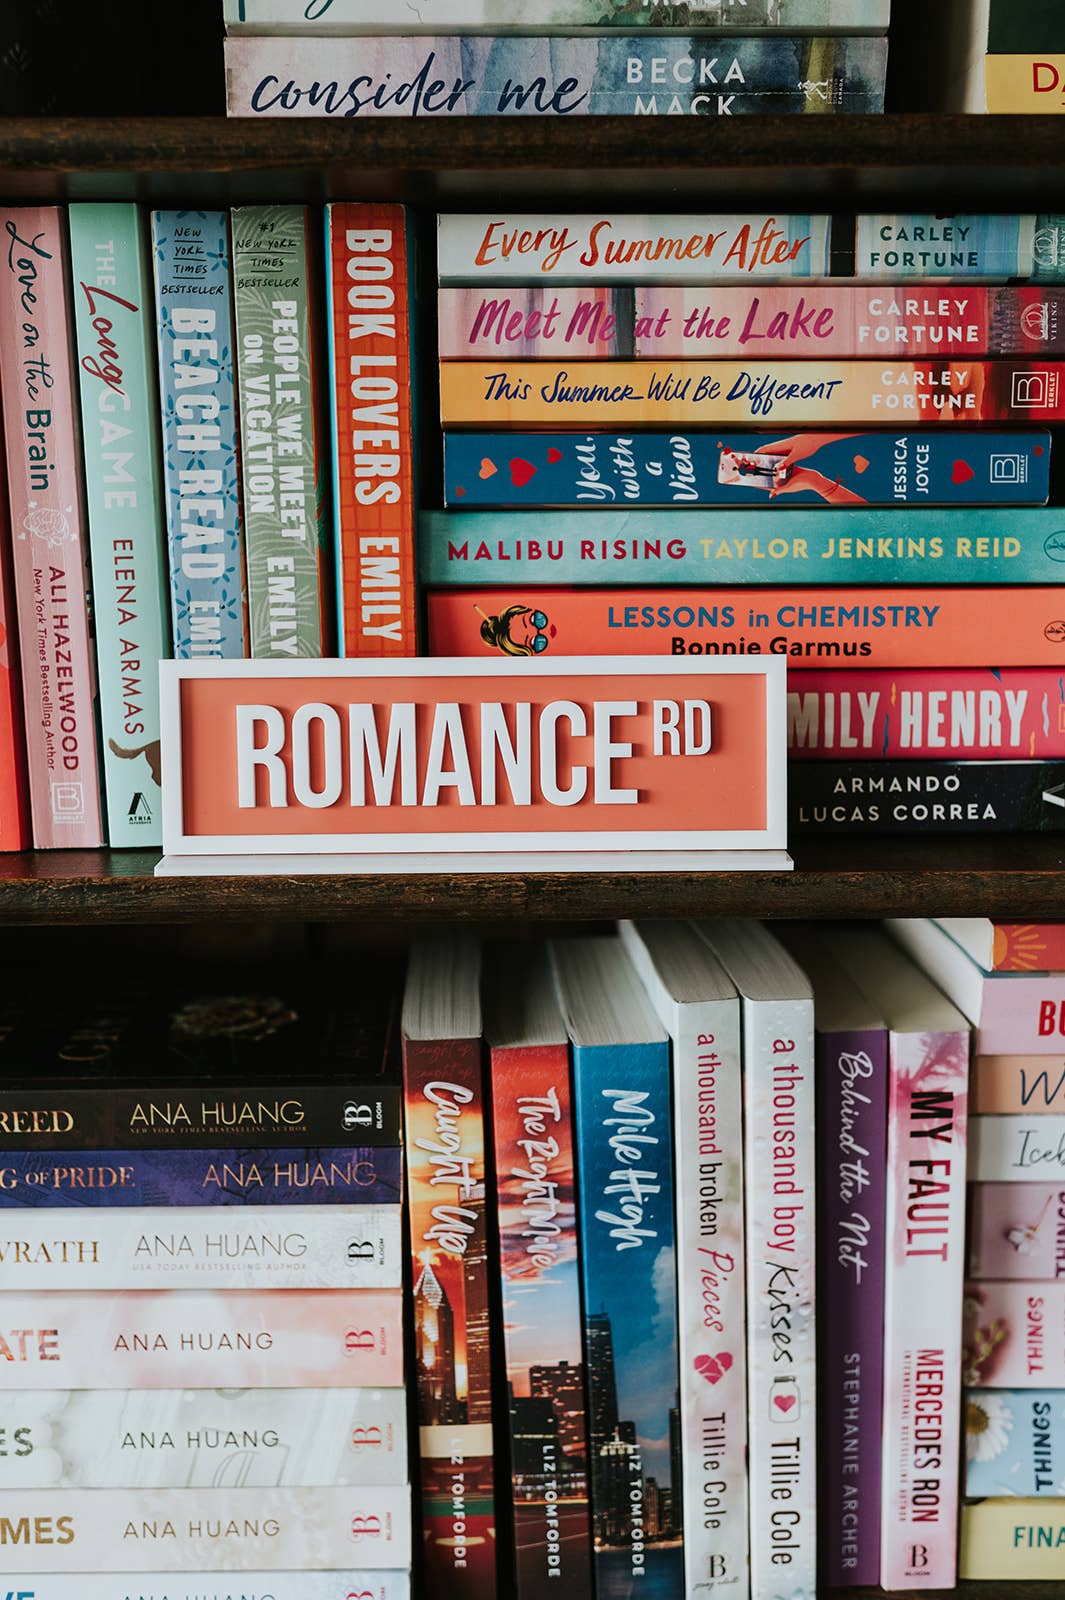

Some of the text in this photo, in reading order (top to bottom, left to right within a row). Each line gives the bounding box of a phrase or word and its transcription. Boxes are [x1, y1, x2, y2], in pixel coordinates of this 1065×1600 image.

[251, 51, 589, 117] consider me
[626, 57, 746, 83] BECKA
[634, 95, 736, 115] MACK
[174, 227, 202, 237] NEW
[174, 244, 205, 256] YORK
[235, 237, 298, 249] NEW YORK
[258, 222, 275, 233] #1
[474, 217, 811, 273] Every Summer After
[879, 226, 971, 242] CARLEY
[173, 263, 208, 275] TIMES
[237, 276, 301, 289] BESTSELLER
[251, 256, 285, 267] TIMES
[870, 251, 979, 267] FORTUNE
[161, 284, 225, 296] BESTSELLER
[868, 299, 969, 316] CARLEY
[468, 296, 835, 345] Meet Me at the Lake
[858, 325, 980, 344] FORTUNE
[1050, 301, 1058, 341] VIKING
[5, 220, 56, 491] Love on the Brain
[80, 239, 140, 510] THE Long GAME
[345, 229, 402, 506] BOOK LOVERS
[880, 370, 969, 386] CARLEY
[483, 371, 534, 401] This
[647, 371, 687, 402] Will
[692, 376, 722, 402] Be
[871, 393, 977, 409] FORTUNE
[1048, 371, 1056, 408] BERKLEY
[171, 307, 226, 580] BEACH READ
[242, 333, 276, 514] ON VACATION
[271, 300, 307, 542] PEOPLE WE MEET
[608, 437, 641, 499] with
[645, 461, 664, 476] a
[668, 435, 700, 501] View
[893, 436, 908, 500] JESSICA
[915, 443, 930, 494] JOYCE
[447, 536, 1022, 562] MALIBU RISING TAYLOR JENKINS REID
[266, 556, 299, 656] EMILY
[358, 536, 403, 641] EMILY
[112, 538, 145, 736] ELENA ARMAS
[607, 605, 941, 629] LESSONS in CHEMISTRY
[32, 568, 56, 770] New York Times Bestselling Author
[48, 565, 80, 771] ALI HAZELWOOD
[671, 636, 873, 657] Bonnie Garmus
[899, 689, 1029, 748] HENRY
[235, 698, 712, 809] ROMANCE RD
[833, 775, 961, 793] ARMANDO
[799, 803, 998, 823] LUCAS CORREA
[130, 1100, 305, 1126] ANA HUANG
[375, 1102, 383, 1130] BLOOM
[516, 1086, 561, 1136] The
[601, 1088, 659, 1164] Mile
[414, 1081, 477, 1199] Caught
[25, 1166, 136, 1189] OF PRIDE
[202, 1161, 378, 1188] ANA HUANG
[510, 1136, 560, 1206] Right
[697, 1033, 735, 1333] a thousand broken Pieces
[837, 1051, 874, 1286] Behind the Net
[905, 1091, 955, 1262] MY FAULT
[594, 1167, 661, 1252] High
[765, 1038, 805, 1364] a thousand boy Kisses
[134, 1233, 308, 1258] ANA HUANG
[422, 1205, 479, 1254] Up
[520, 1208, 562, 1270] Move
[113, 1332, 274, 1352] ANA HUANG
[1026, 1296, 1044, 1376] THINGS
[121, 1430, 280, 1449] ANA HUANG
[840, 1352, 862, 1569] STEPHANIE ARCHER
[911, 1349, 945, 1523] MERCEDES RON
[1033, 1401, 1054, 1492] THINGS
[702, 1411, 728, 1530] Tillie Cole
[450, 1438, 467, 1569] LIZ TOMFORDE
[542, 1445, 561, 1578] LIZ TOMFORDE
[628, 1444, 645, 1577] LIZ TOMFORDE
[770, 1436, 801, 1566] Tillie Cole
[123, 1519, 281, 1539] ANA HUANG
